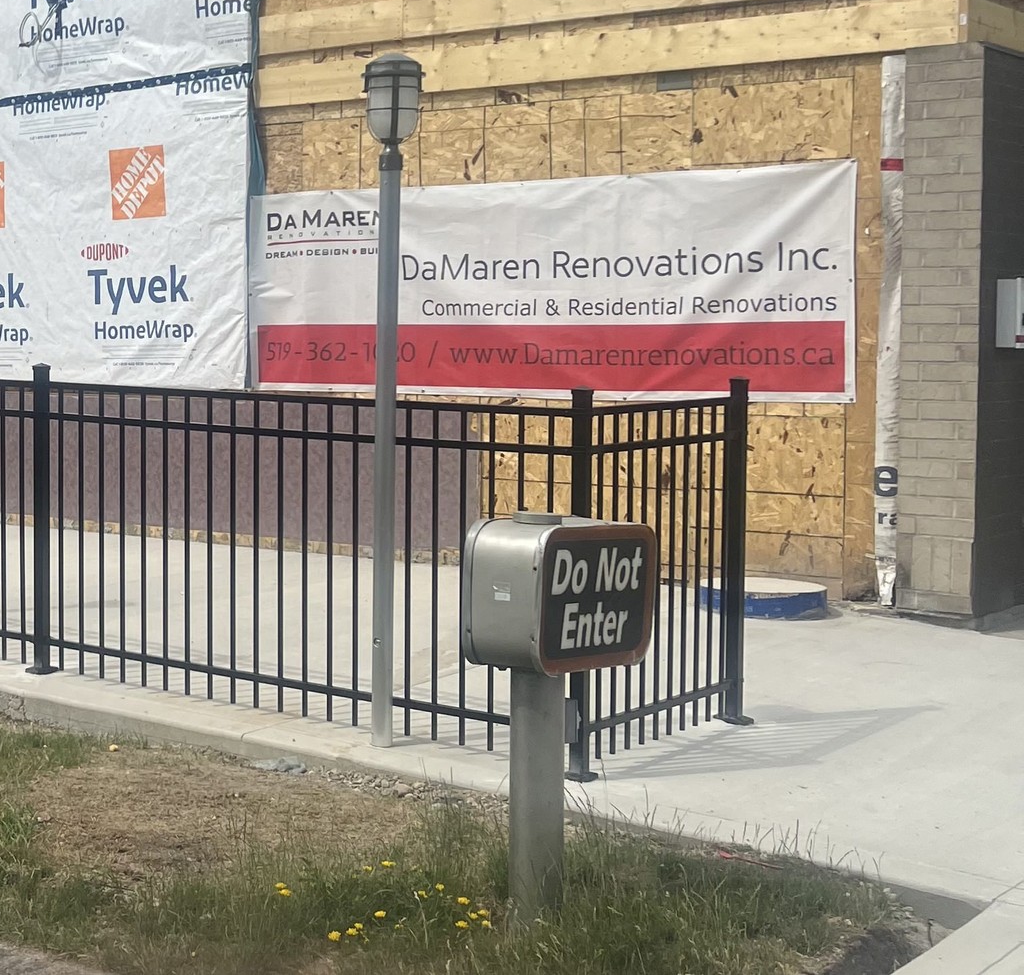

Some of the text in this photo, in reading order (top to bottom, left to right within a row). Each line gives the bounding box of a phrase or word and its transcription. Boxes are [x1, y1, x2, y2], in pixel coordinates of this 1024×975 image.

[267, 229, 376, 241] RENOVATION
[86, 242, 124, 261] DUPONT
[360, 246, 378, 255] BUI
[401, 241, 838, 281] DaMaren Renovations Inc.
[87, 264, 190, 316] Tyvek
[422, 292, 837, 317] Commercial & Residential Renovations
[94, 319, 194, 343] HomeWrap
[266, 341, 416, 363] 519-362-10
[449, 341, 836, 367] www.Damarenrenovations.ca
[551, 546, 643, 595] Do Not
[560, 601, 629, 650] Enter
